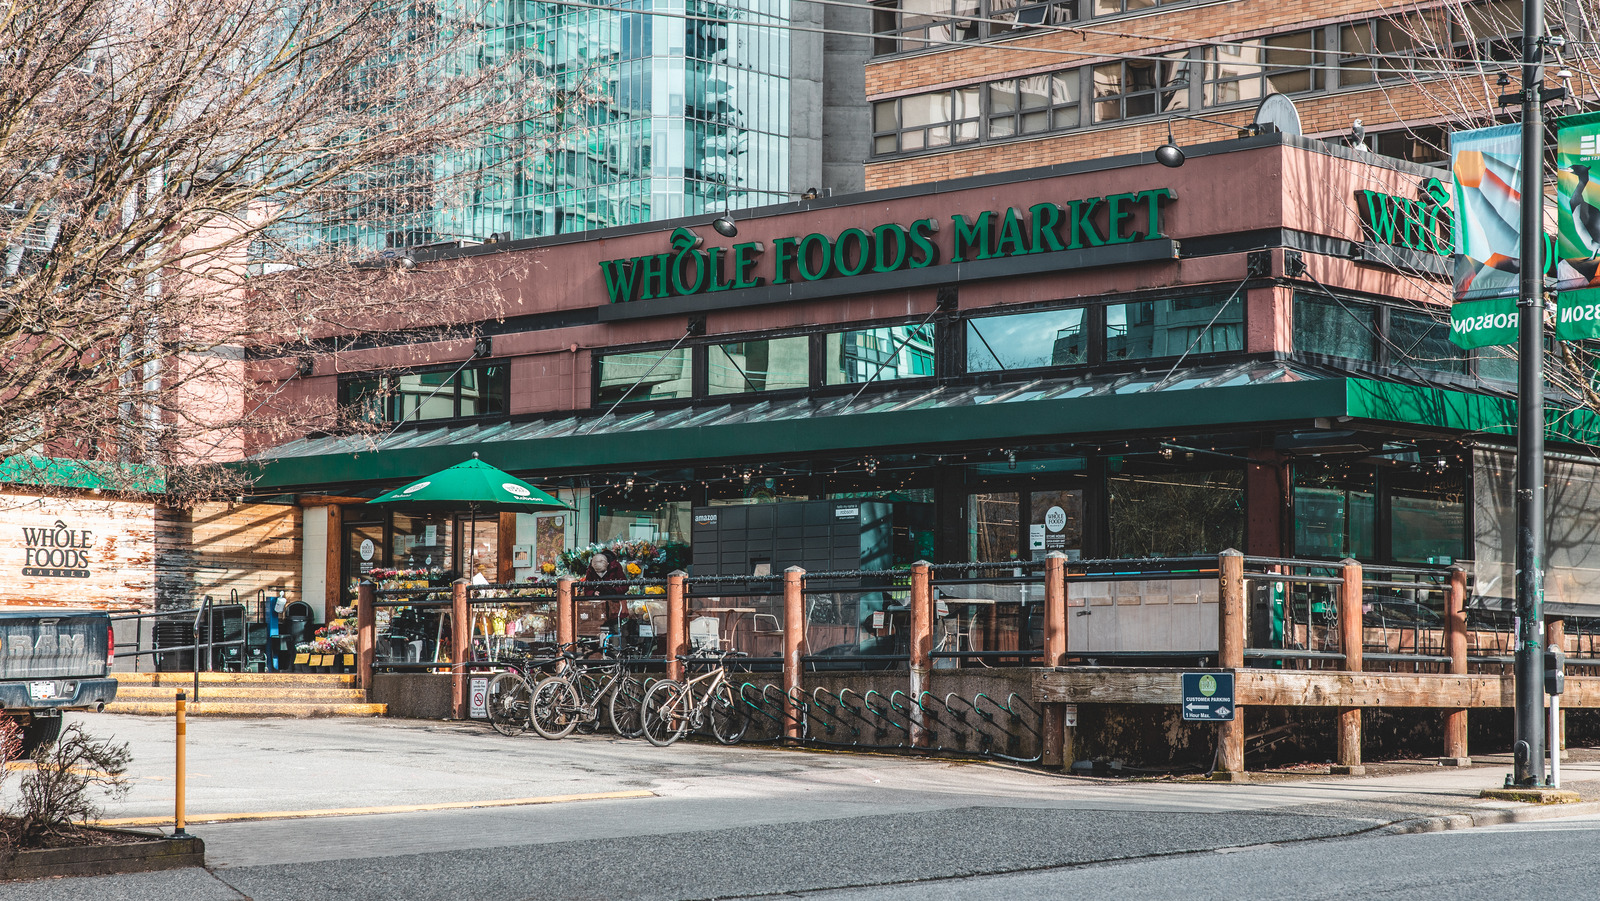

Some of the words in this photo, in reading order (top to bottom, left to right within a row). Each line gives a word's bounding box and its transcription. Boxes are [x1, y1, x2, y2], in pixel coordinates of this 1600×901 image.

[1362, 177, 1455, 256] WHO
[599, 227, 764, 304] WHOLE
[772, 217, 939, 285] FOODS
[951, 187, 1177, 263] MARKET
[22, 520, 93, 548] WHOLE
[24, 548, 89, 568] FOODS
[26, 569, 86, 577] MARKET
[8, 633, 85, 657] RAM
